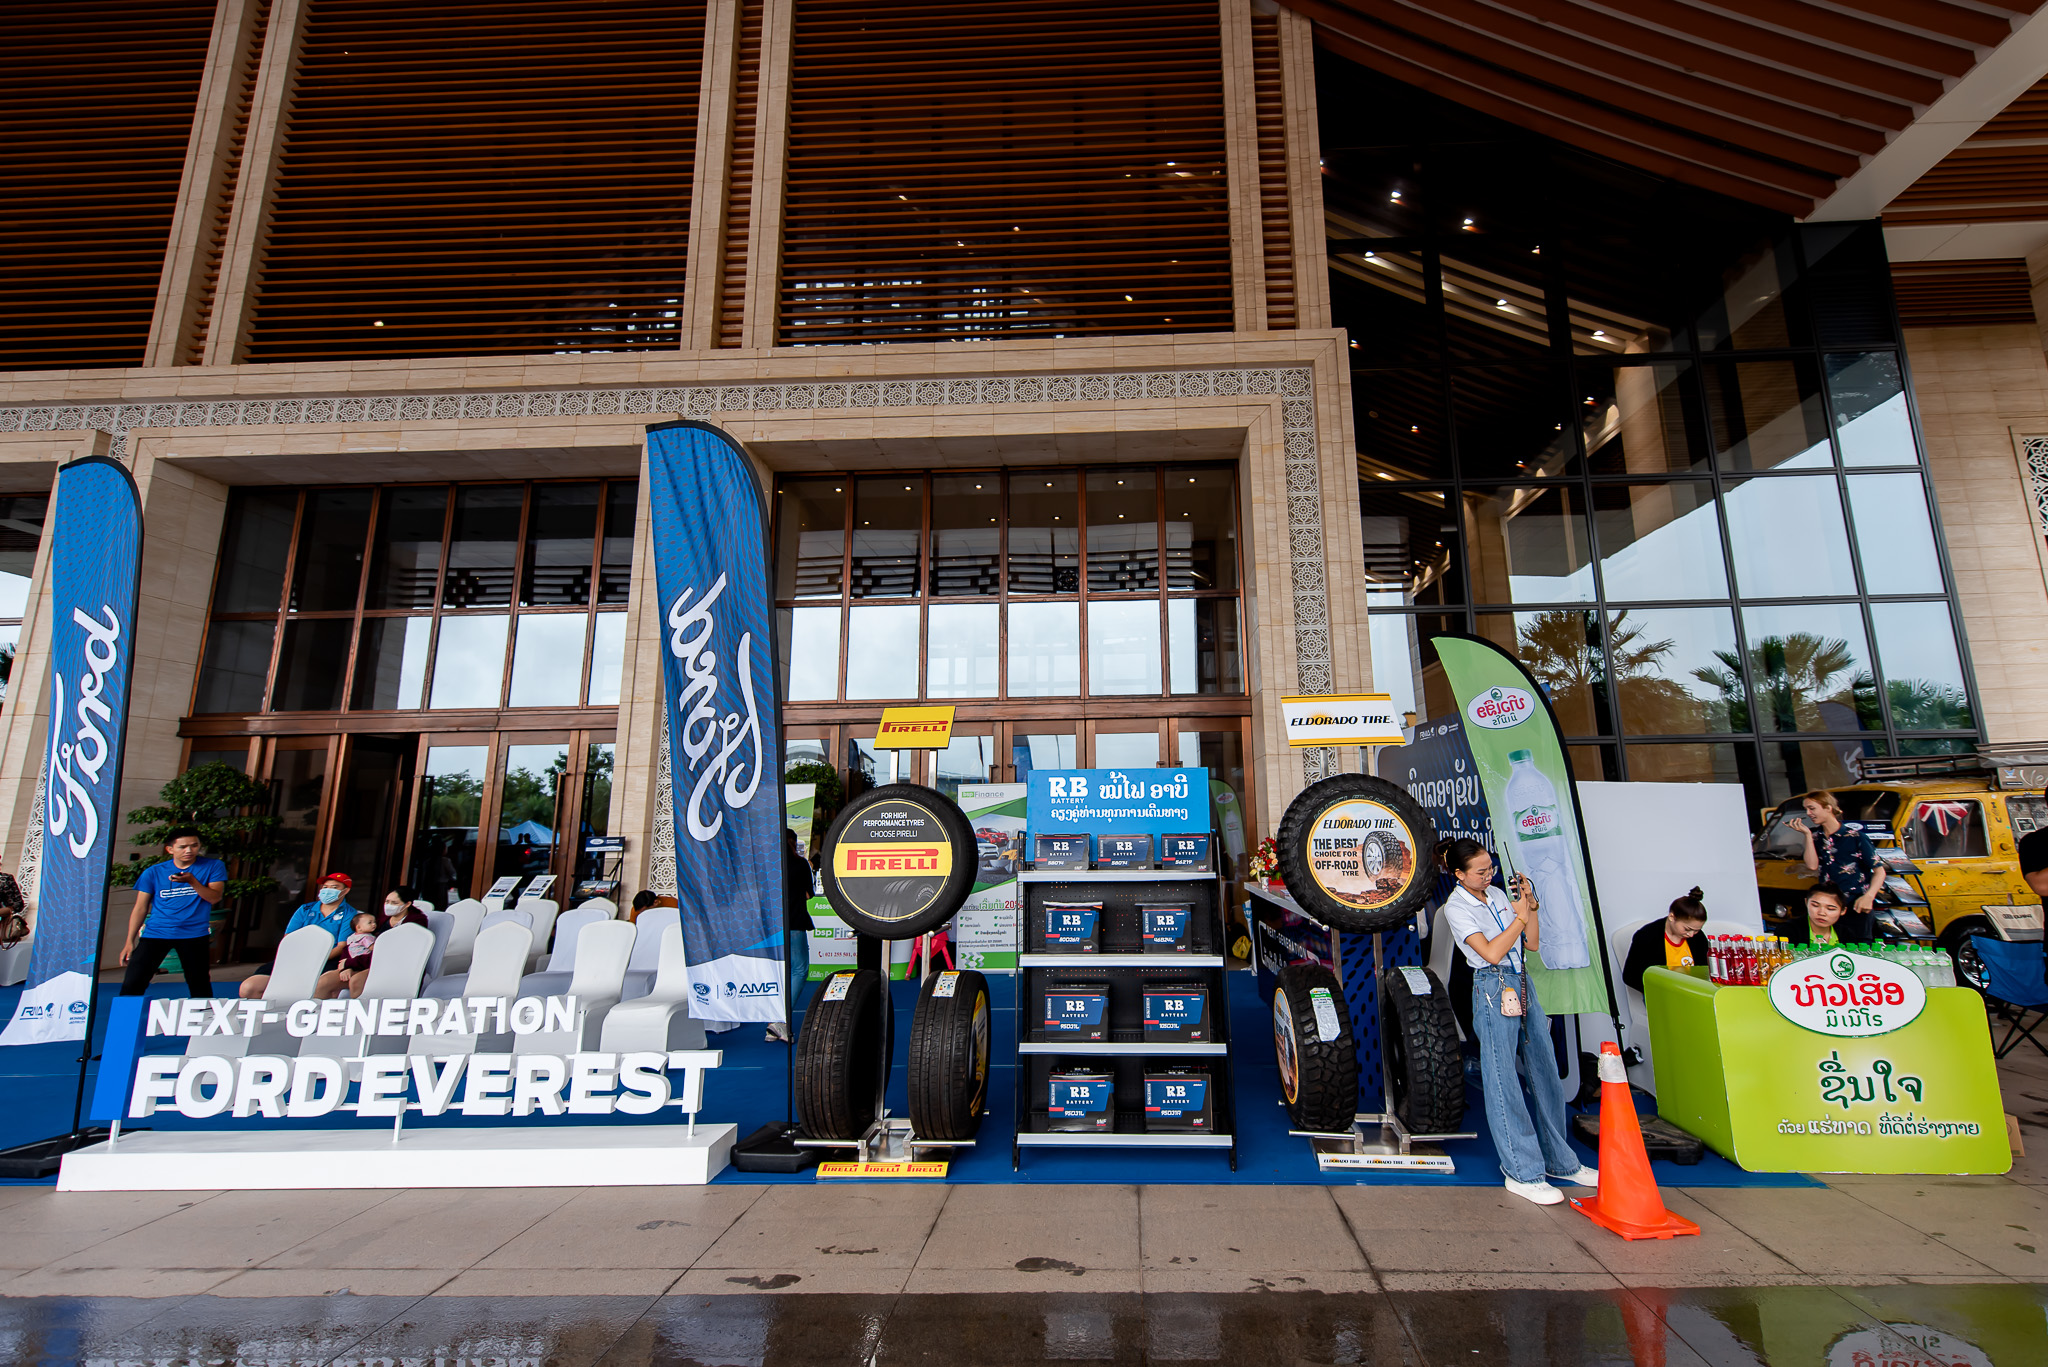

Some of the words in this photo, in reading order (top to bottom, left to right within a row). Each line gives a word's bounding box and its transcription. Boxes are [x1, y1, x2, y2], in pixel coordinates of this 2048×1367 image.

[882, 720, 949, 733] PIRELLI
[1291, 715, 1359, 727] ELDORADO
[1362, 715, 1392, 724] TIRE
[49, 604, 121, 859] Ford
[1049, 776, 1089, 798] RB
[1099, 771, 1146, 800] ໝໍ້ໄຟ
[1150, 773, 1189, 799] ອາບີ
[863, 819, 906, 827] PERFORMANCE
[906, 819, 925, 827] TYRES
[1322, 819, 1372, 829] ELDORADO
[1374, 818, 1397, 829] TIRE
[869, 830, 896, 838] CHOOSE
[896, 830, 918, 838] PIRELLI
[1052, 841, 1070, 851] RB
[1115, 841, 1133, 851] RB
[1177, 840, 1196, 850] RB
[1313, 838, 1333, 850] THE
[1335, 838, 1359, 849] BEST
[846, 848, 940, 870] PIRELLI
[1315, 860, 1359, 870] OFF-ROAD
[1062, 914, 1082, 926] RB
[1156, 915, 1175, 926] RB
[815, 928, 833, 938] bsp
[1790, 973, 1905, 1008] ຫົວເສືອ
[1065, 1000, 1086, 1012] RB
[1164, 999, 1185, 1011] RB
[128, 1054, 350, 1119] FORD
[356, 1049, 723, 1118] EVEREST
[1818, 1050, 1923, 1110] ຊື່ນໃຈ
[1069, 1086, 1090, 1098] RB
[1165, 1085, 1186, 1097] RB
[1777, 1118, 1806, 1135] ດ້ວຍ
[1807, 1113, 1873, 1136] ແຮ່ທາດ
[822, 1164, 859, 1172] PIRELLI
[864, 1164, 901, 1172] PIRELLI
[907, 1164, 943, 1173] PIRELLI
